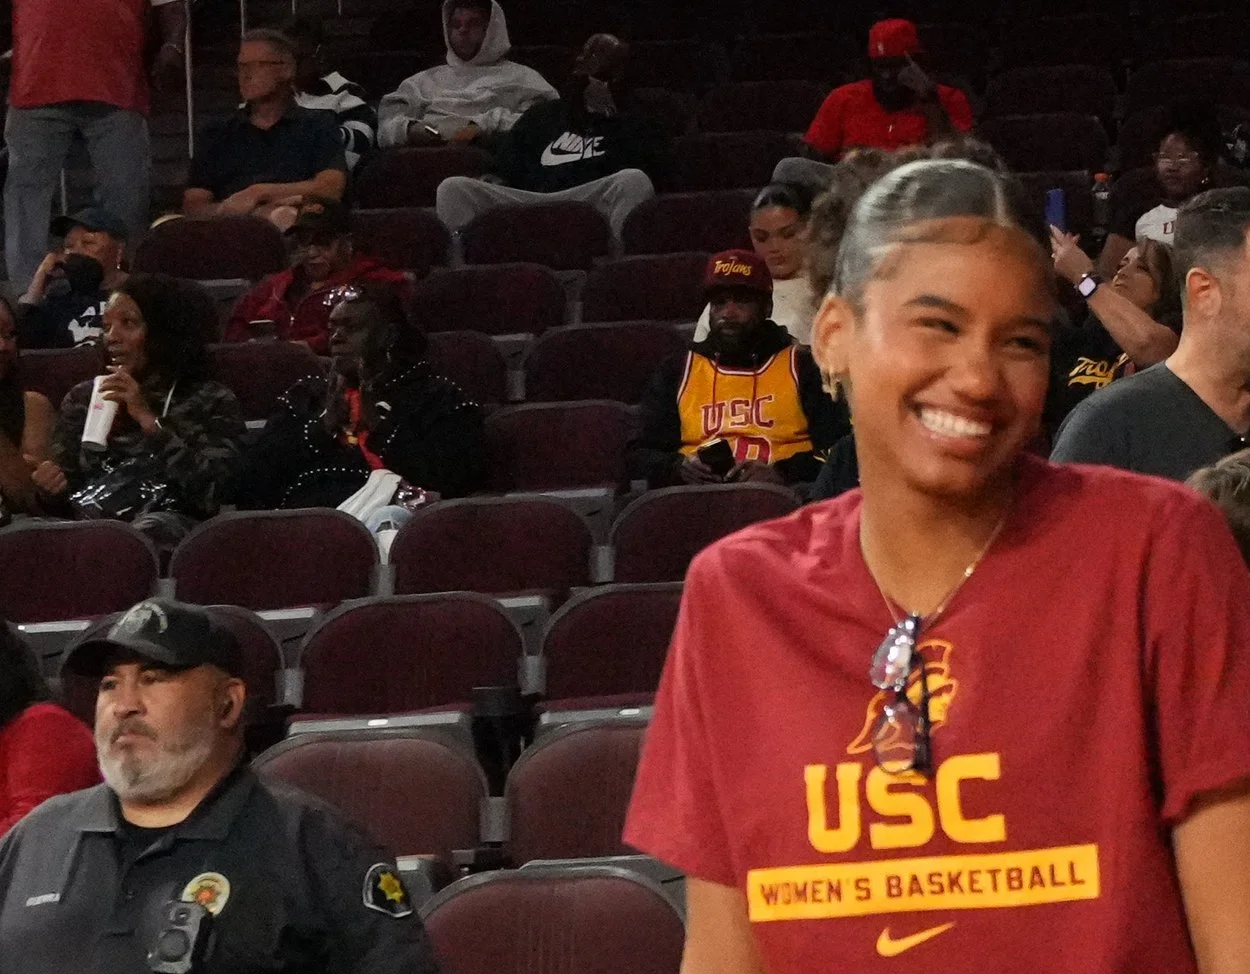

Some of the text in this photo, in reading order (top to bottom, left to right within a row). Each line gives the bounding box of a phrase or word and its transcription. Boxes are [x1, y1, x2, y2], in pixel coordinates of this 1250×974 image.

[713, 259, 752, 277] Trojans
[702, 395, 774, 437] USC
[804, 752, 1006, 854] USC
[886, 861, 1086, 899] BASKETBALL
